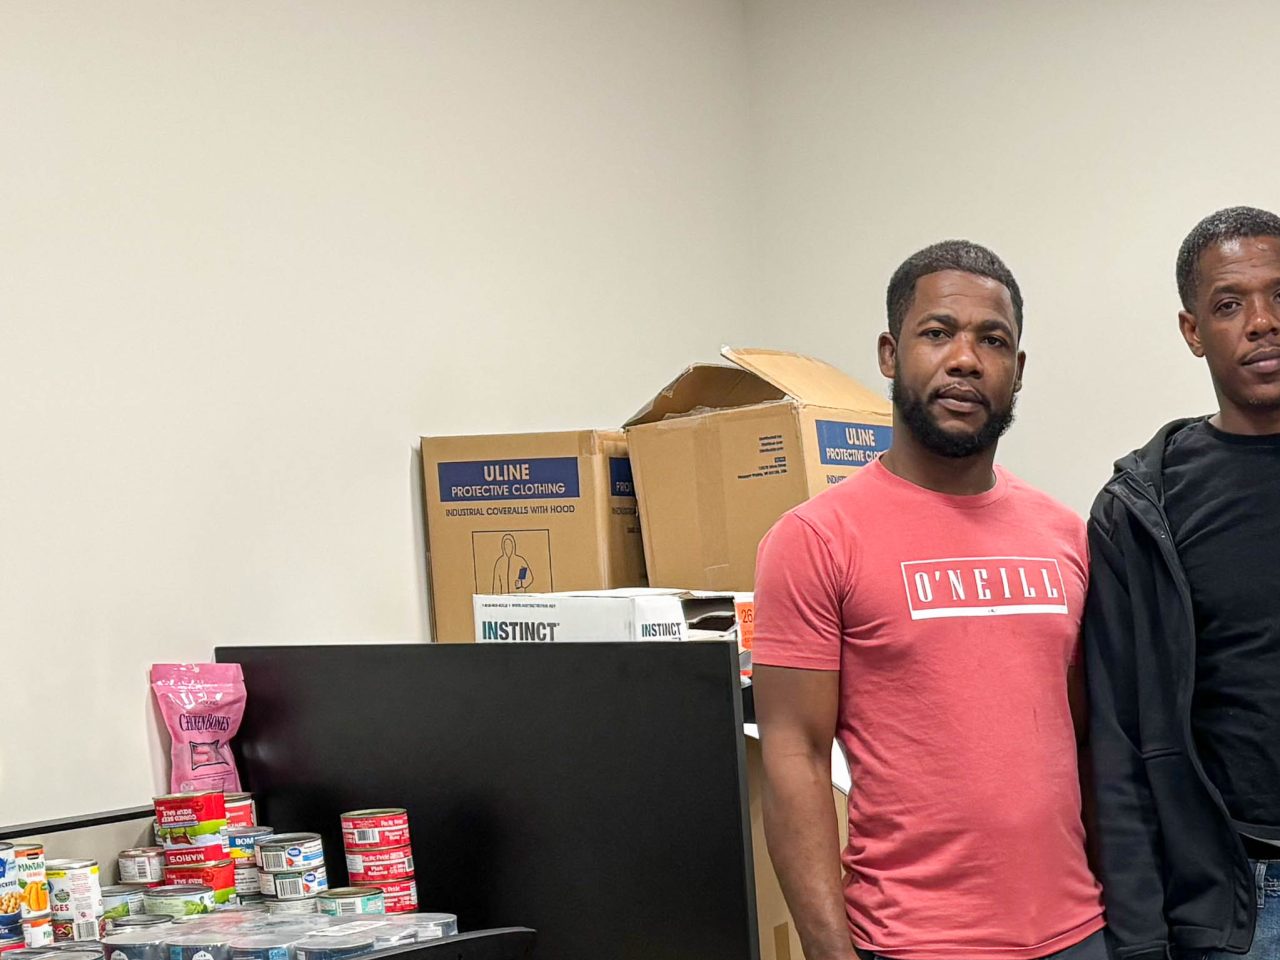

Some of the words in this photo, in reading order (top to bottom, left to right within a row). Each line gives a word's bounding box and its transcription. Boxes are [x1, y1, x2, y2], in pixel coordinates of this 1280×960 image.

[845, 427, 876, 447] ULINE
[826, 447, 865, 462] PROTECTIVE
[483, 463, 530, 482] ULINE
[451, 484, 509, 498] PROTECTIVE
[512, 482, 566, 496] CLOTHING
[445, 507, 485, 518] INDUSTRIAL
[486, 506, 529, 516] COVERALLS
[530, 505, 549, 515] WITH
[550, 505, 576, 514] HOOD
[914, 567, 1059, 603] O'NEILL
[482, 621, 558, 642] INSTINCT
[641, 622, 682, 638] INSTINCT
